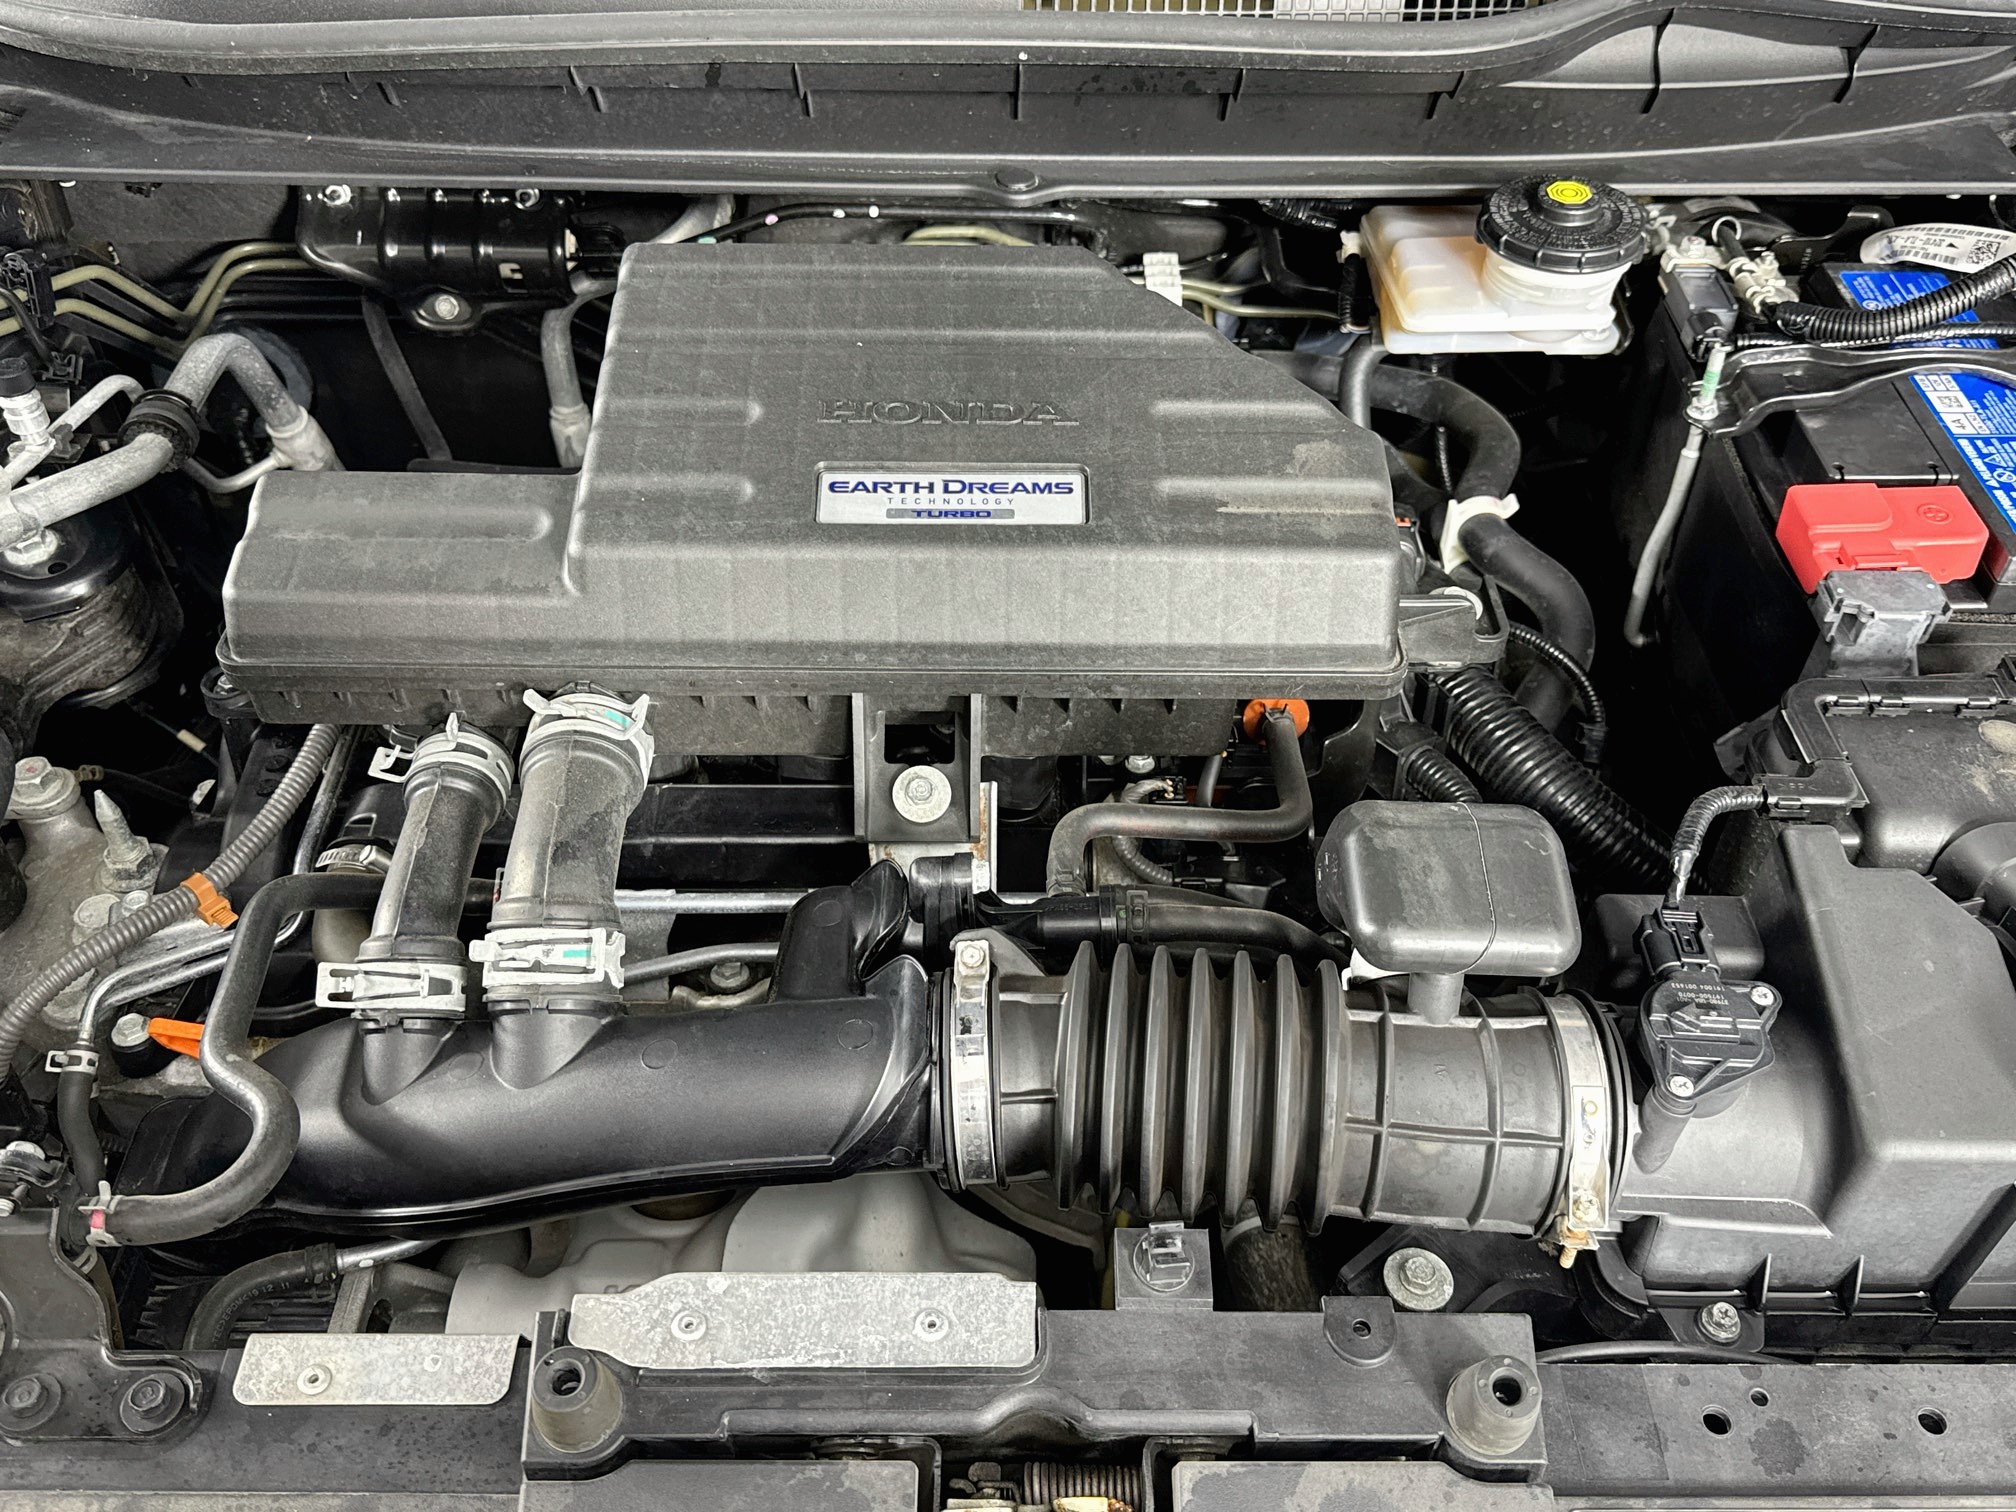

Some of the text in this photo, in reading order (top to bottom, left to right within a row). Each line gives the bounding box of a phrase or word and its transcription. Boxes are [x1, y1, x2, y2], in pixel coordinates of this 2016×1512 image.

[817, 400, 1079, 425] HONDA
[828, 479, 1074, 494] EARTH DREAMS
[911, 510, 992, 518] TURBO
